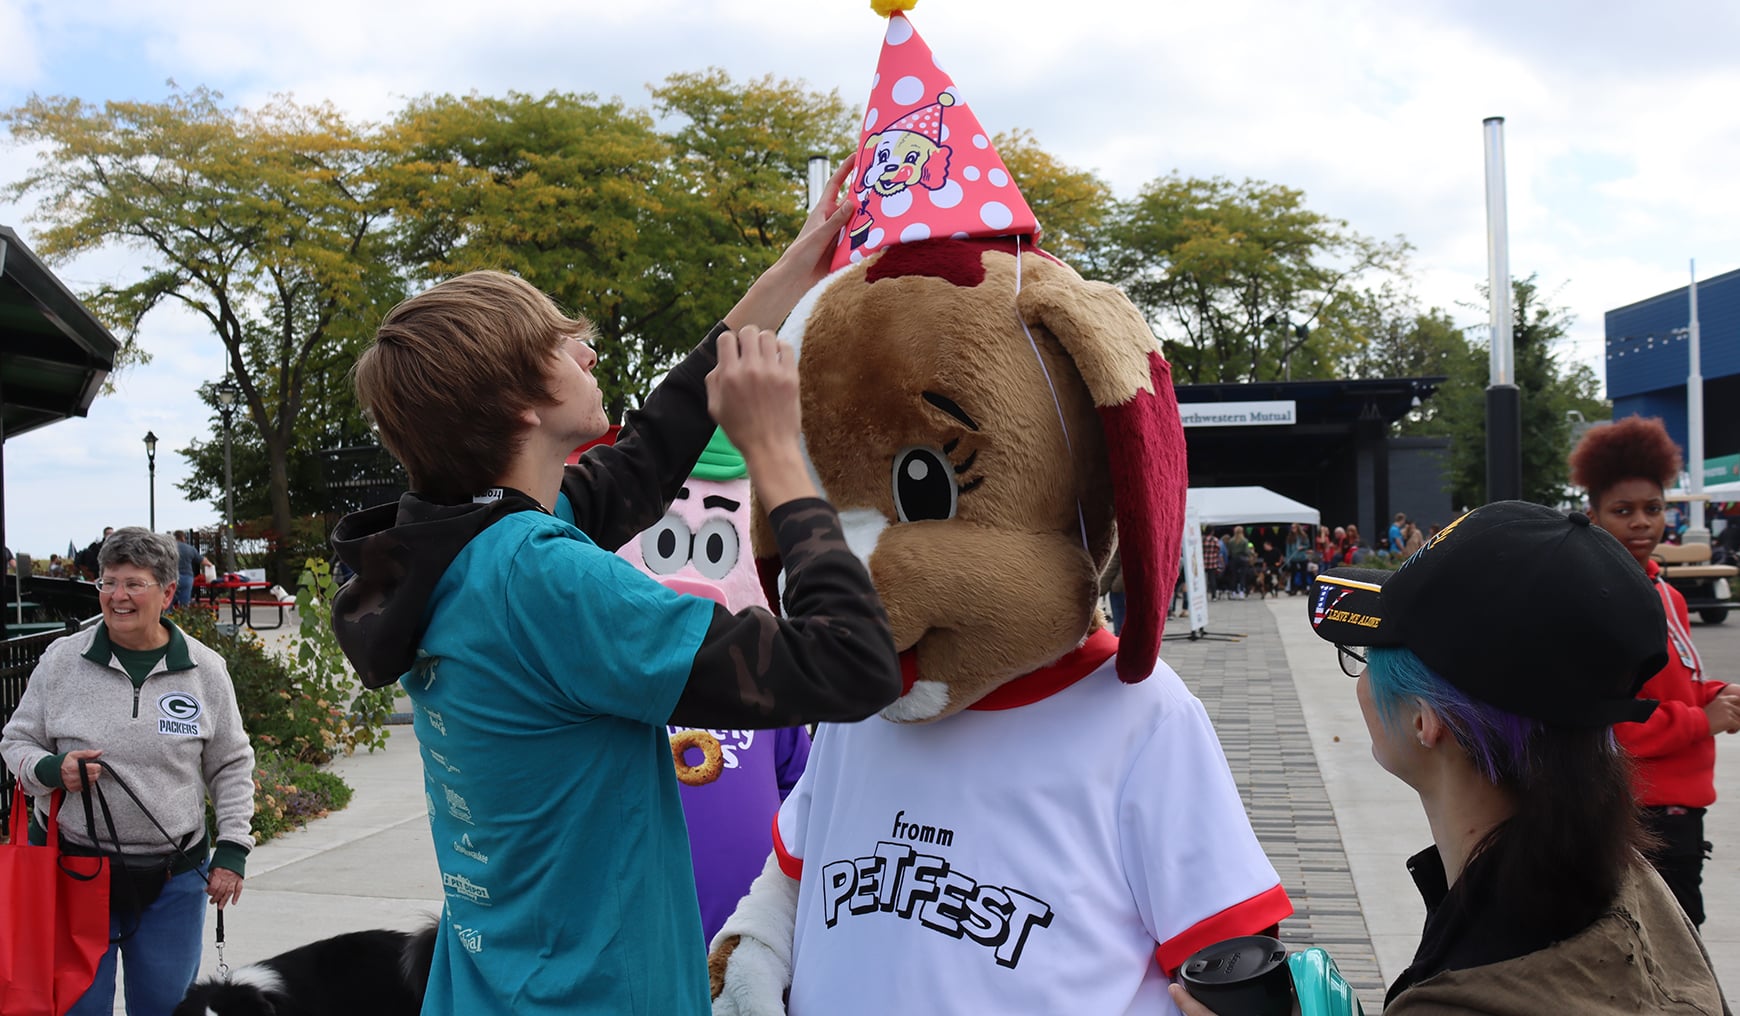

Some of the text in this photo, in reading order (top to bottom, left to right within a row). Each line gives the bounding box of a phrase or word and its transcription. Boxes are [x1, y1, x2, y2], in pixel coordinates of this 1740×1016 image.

[1180, 411, 1292, 424] orthwestern Mutual
[1327, 609, 1382, 629] LEAVE ME ALONE
[160, 719, 198, 735] PACKERS
[892, 810, 954, 847] fromm
[822, 841, 1054, 969] PETFEST
